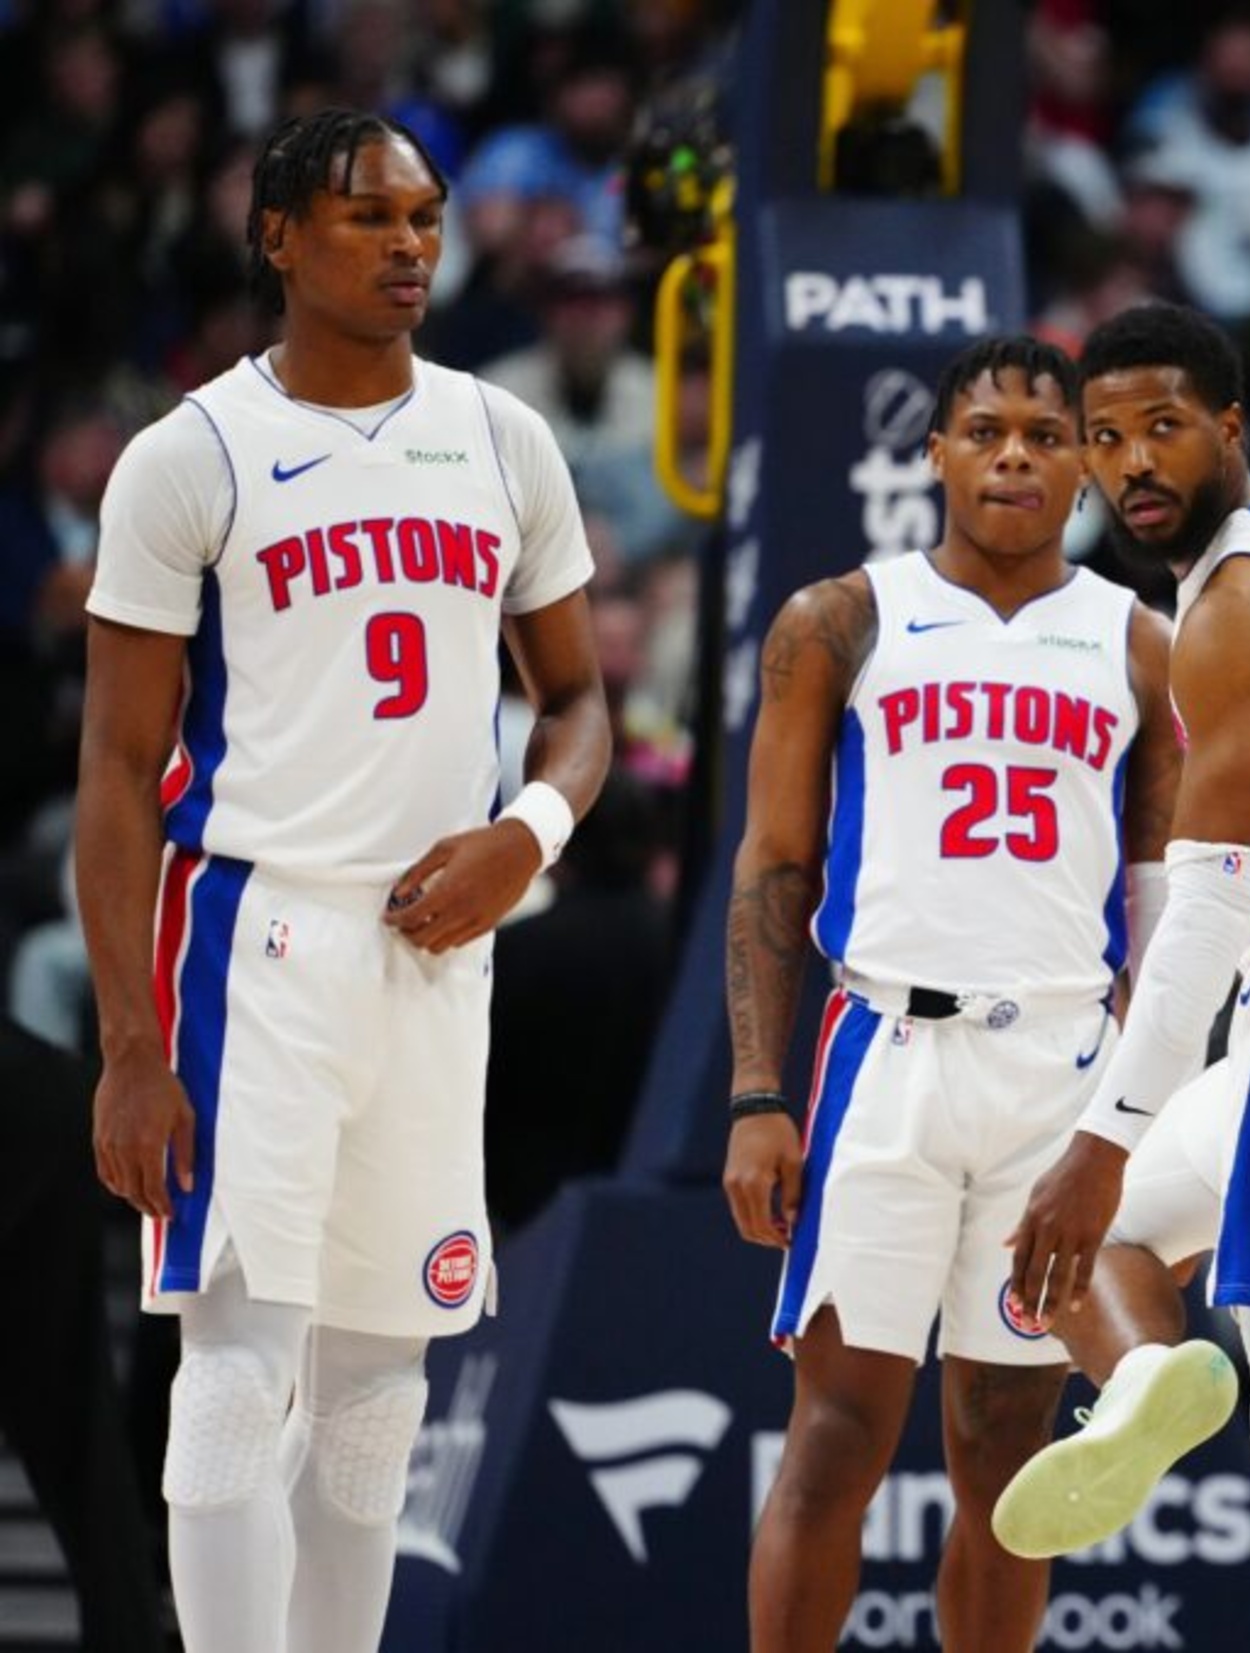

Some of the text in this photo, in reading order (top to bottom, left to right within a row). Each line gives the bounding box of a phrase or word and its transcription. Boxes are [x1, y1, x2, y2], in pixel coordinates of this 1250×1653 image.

[786, 272, 984, 334] PATH
[256, 517, 501, 612] PISTONS
[365, 611, 428, 720] 9
[878, 682, 1119, 772] PISTONS
[940, 763, 1059, 863] 25
